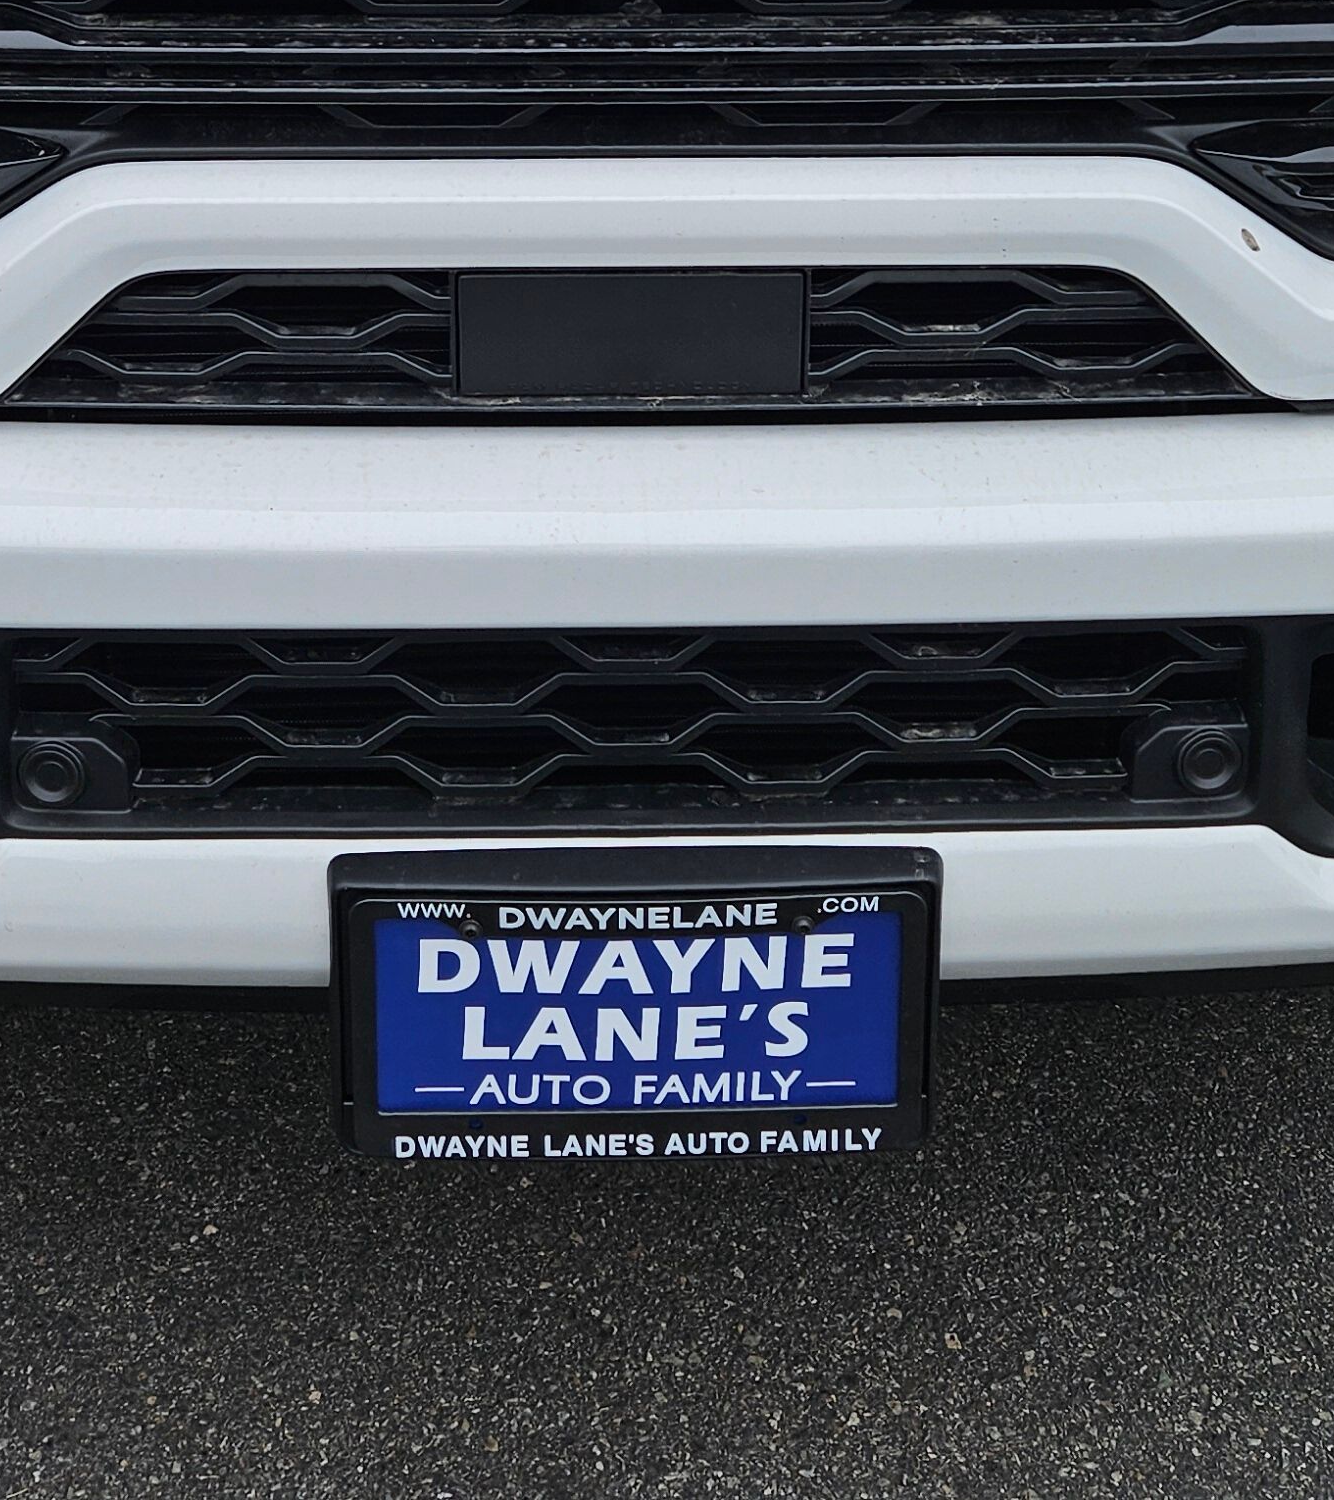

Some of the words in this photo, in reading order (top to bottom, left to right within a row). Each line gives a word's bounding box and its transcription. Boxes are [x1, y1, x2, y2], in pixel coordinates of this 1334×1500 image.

[397, 902, 471, 920] WWW.
[499, 903, 777, 930] DWAYNELANE
[817, 896, 879, 914] .COM
[417, 933, 855, 994] DWAYNE
[462, 1001, 810, 1062] LANE'S
[470, 1074, 611, 1105] AUTO
[633, 1070, 802, 1104] FAMILY
[395, 1134, 529, 1159] DWAYNE
[544, 1133, 654, 1157] LANE'S
[664, 1131, 749, 1155] AUTO
[760, 1128, 882, 1153] FAMILY
